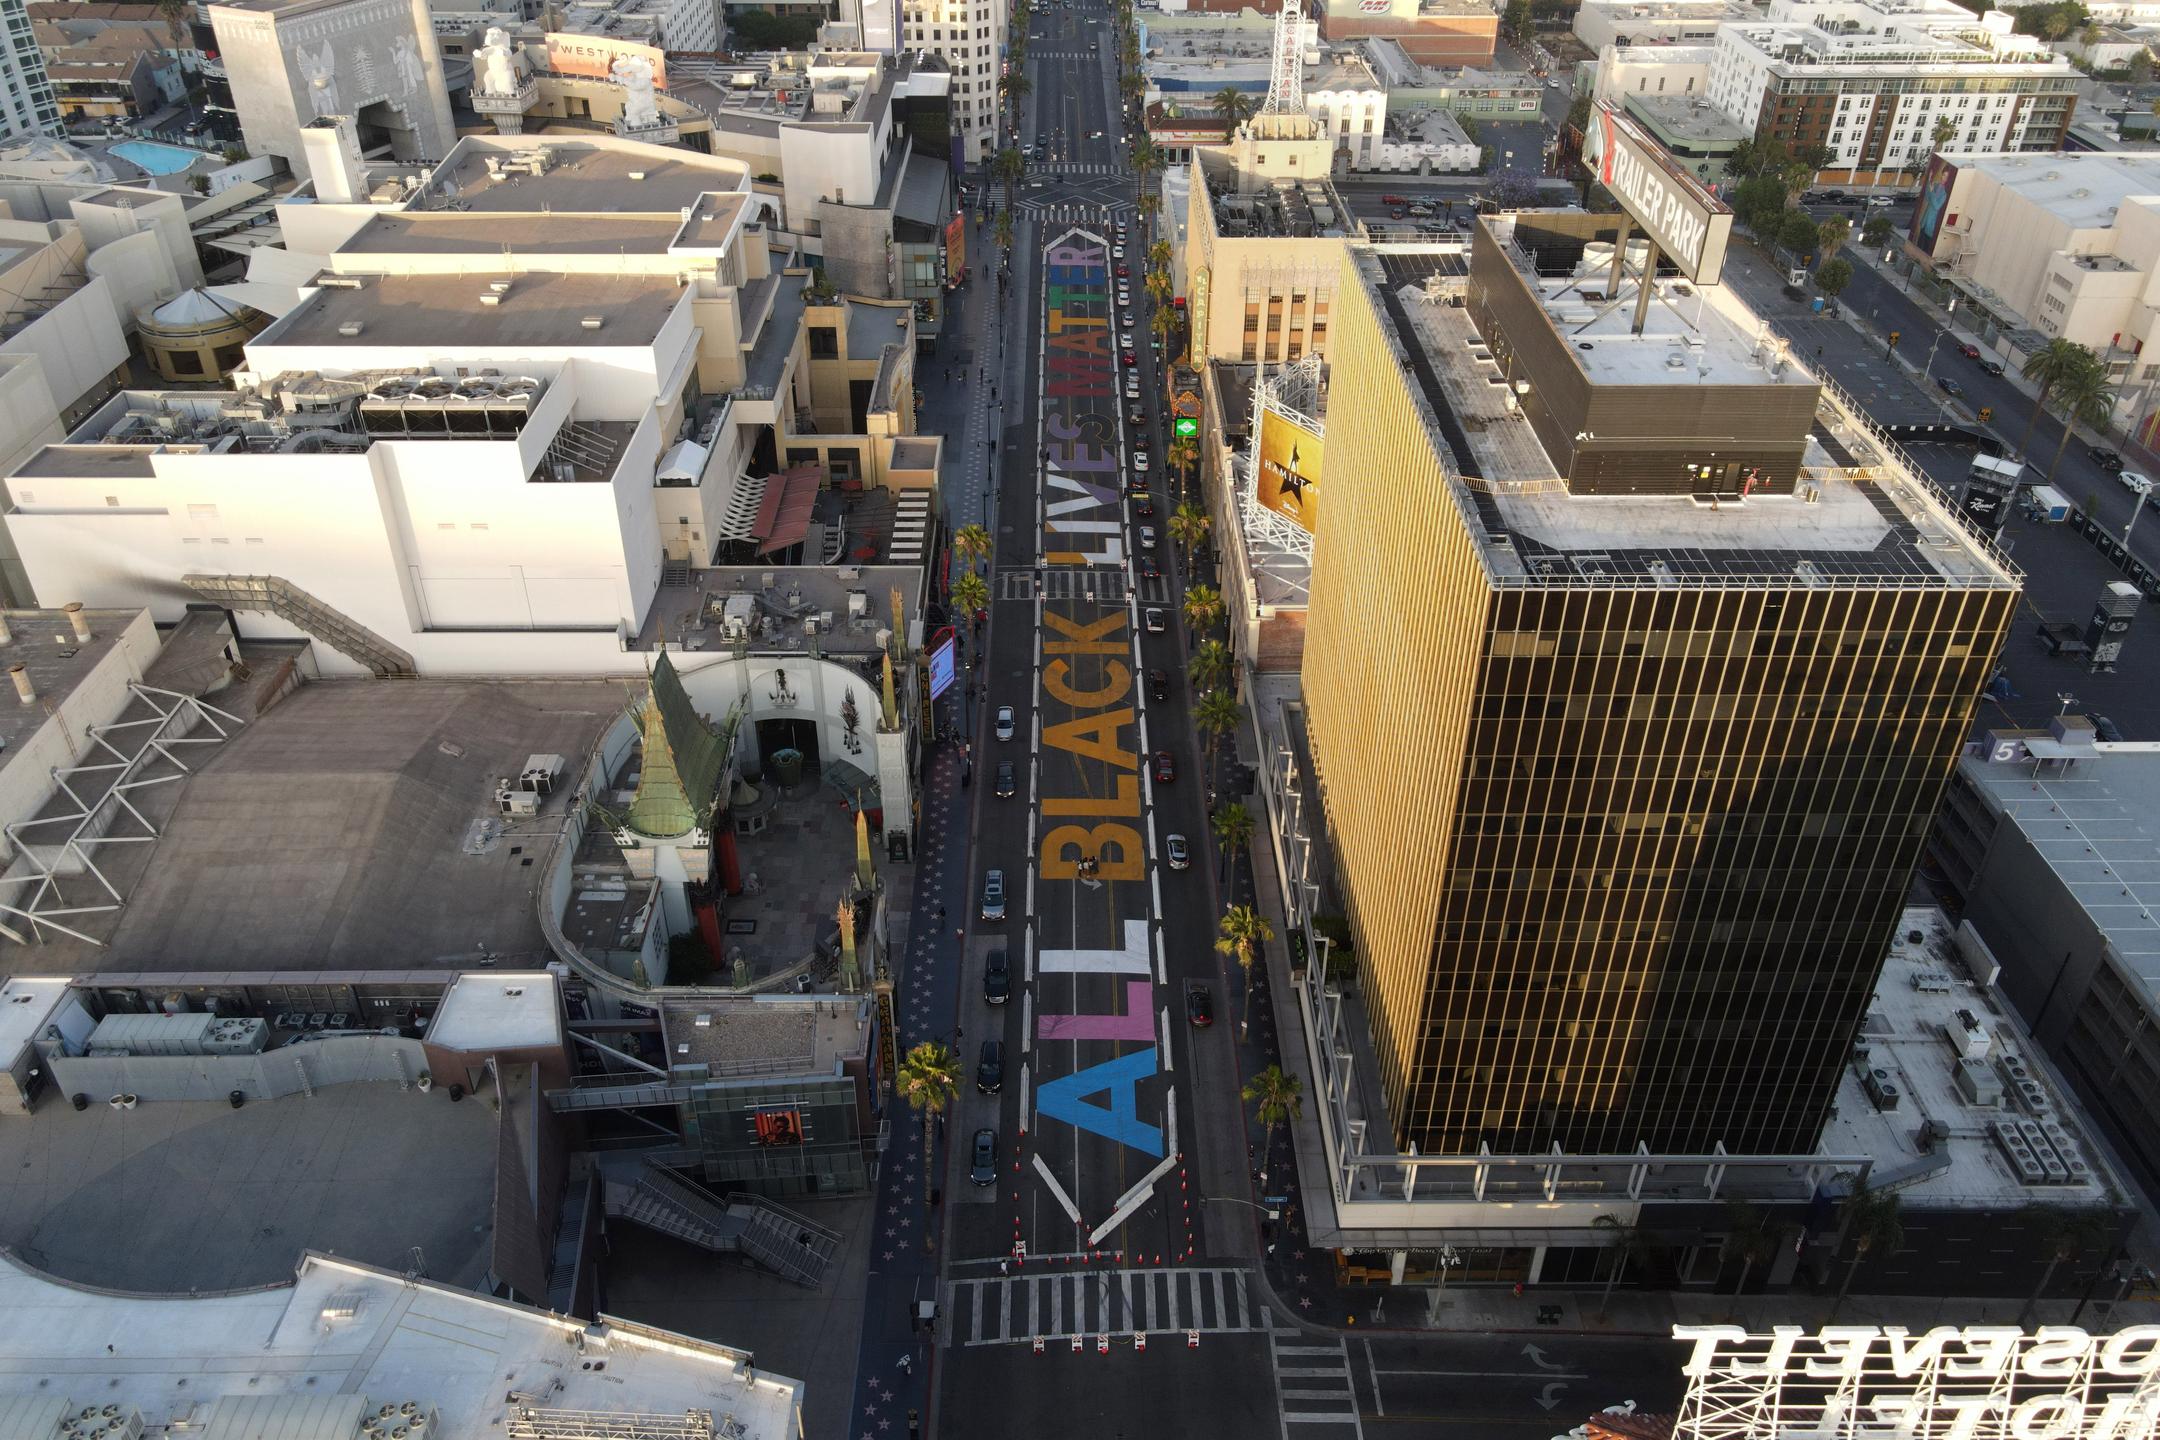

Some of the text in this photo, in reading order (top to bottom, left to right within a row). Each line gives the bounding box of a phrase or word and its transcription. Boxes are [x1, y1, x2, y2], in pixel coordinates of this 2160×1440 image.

[560, 44, 656, 67] WESTWOD
[1611, 139, 1705, 268] TRAILER PARK
[1193, 287, 1206, 364] CAPITAN
[1037, 245, 1163, 1158] ALL BLACK LIVES MATTER
[1994, 742, 2016, 761] 5
